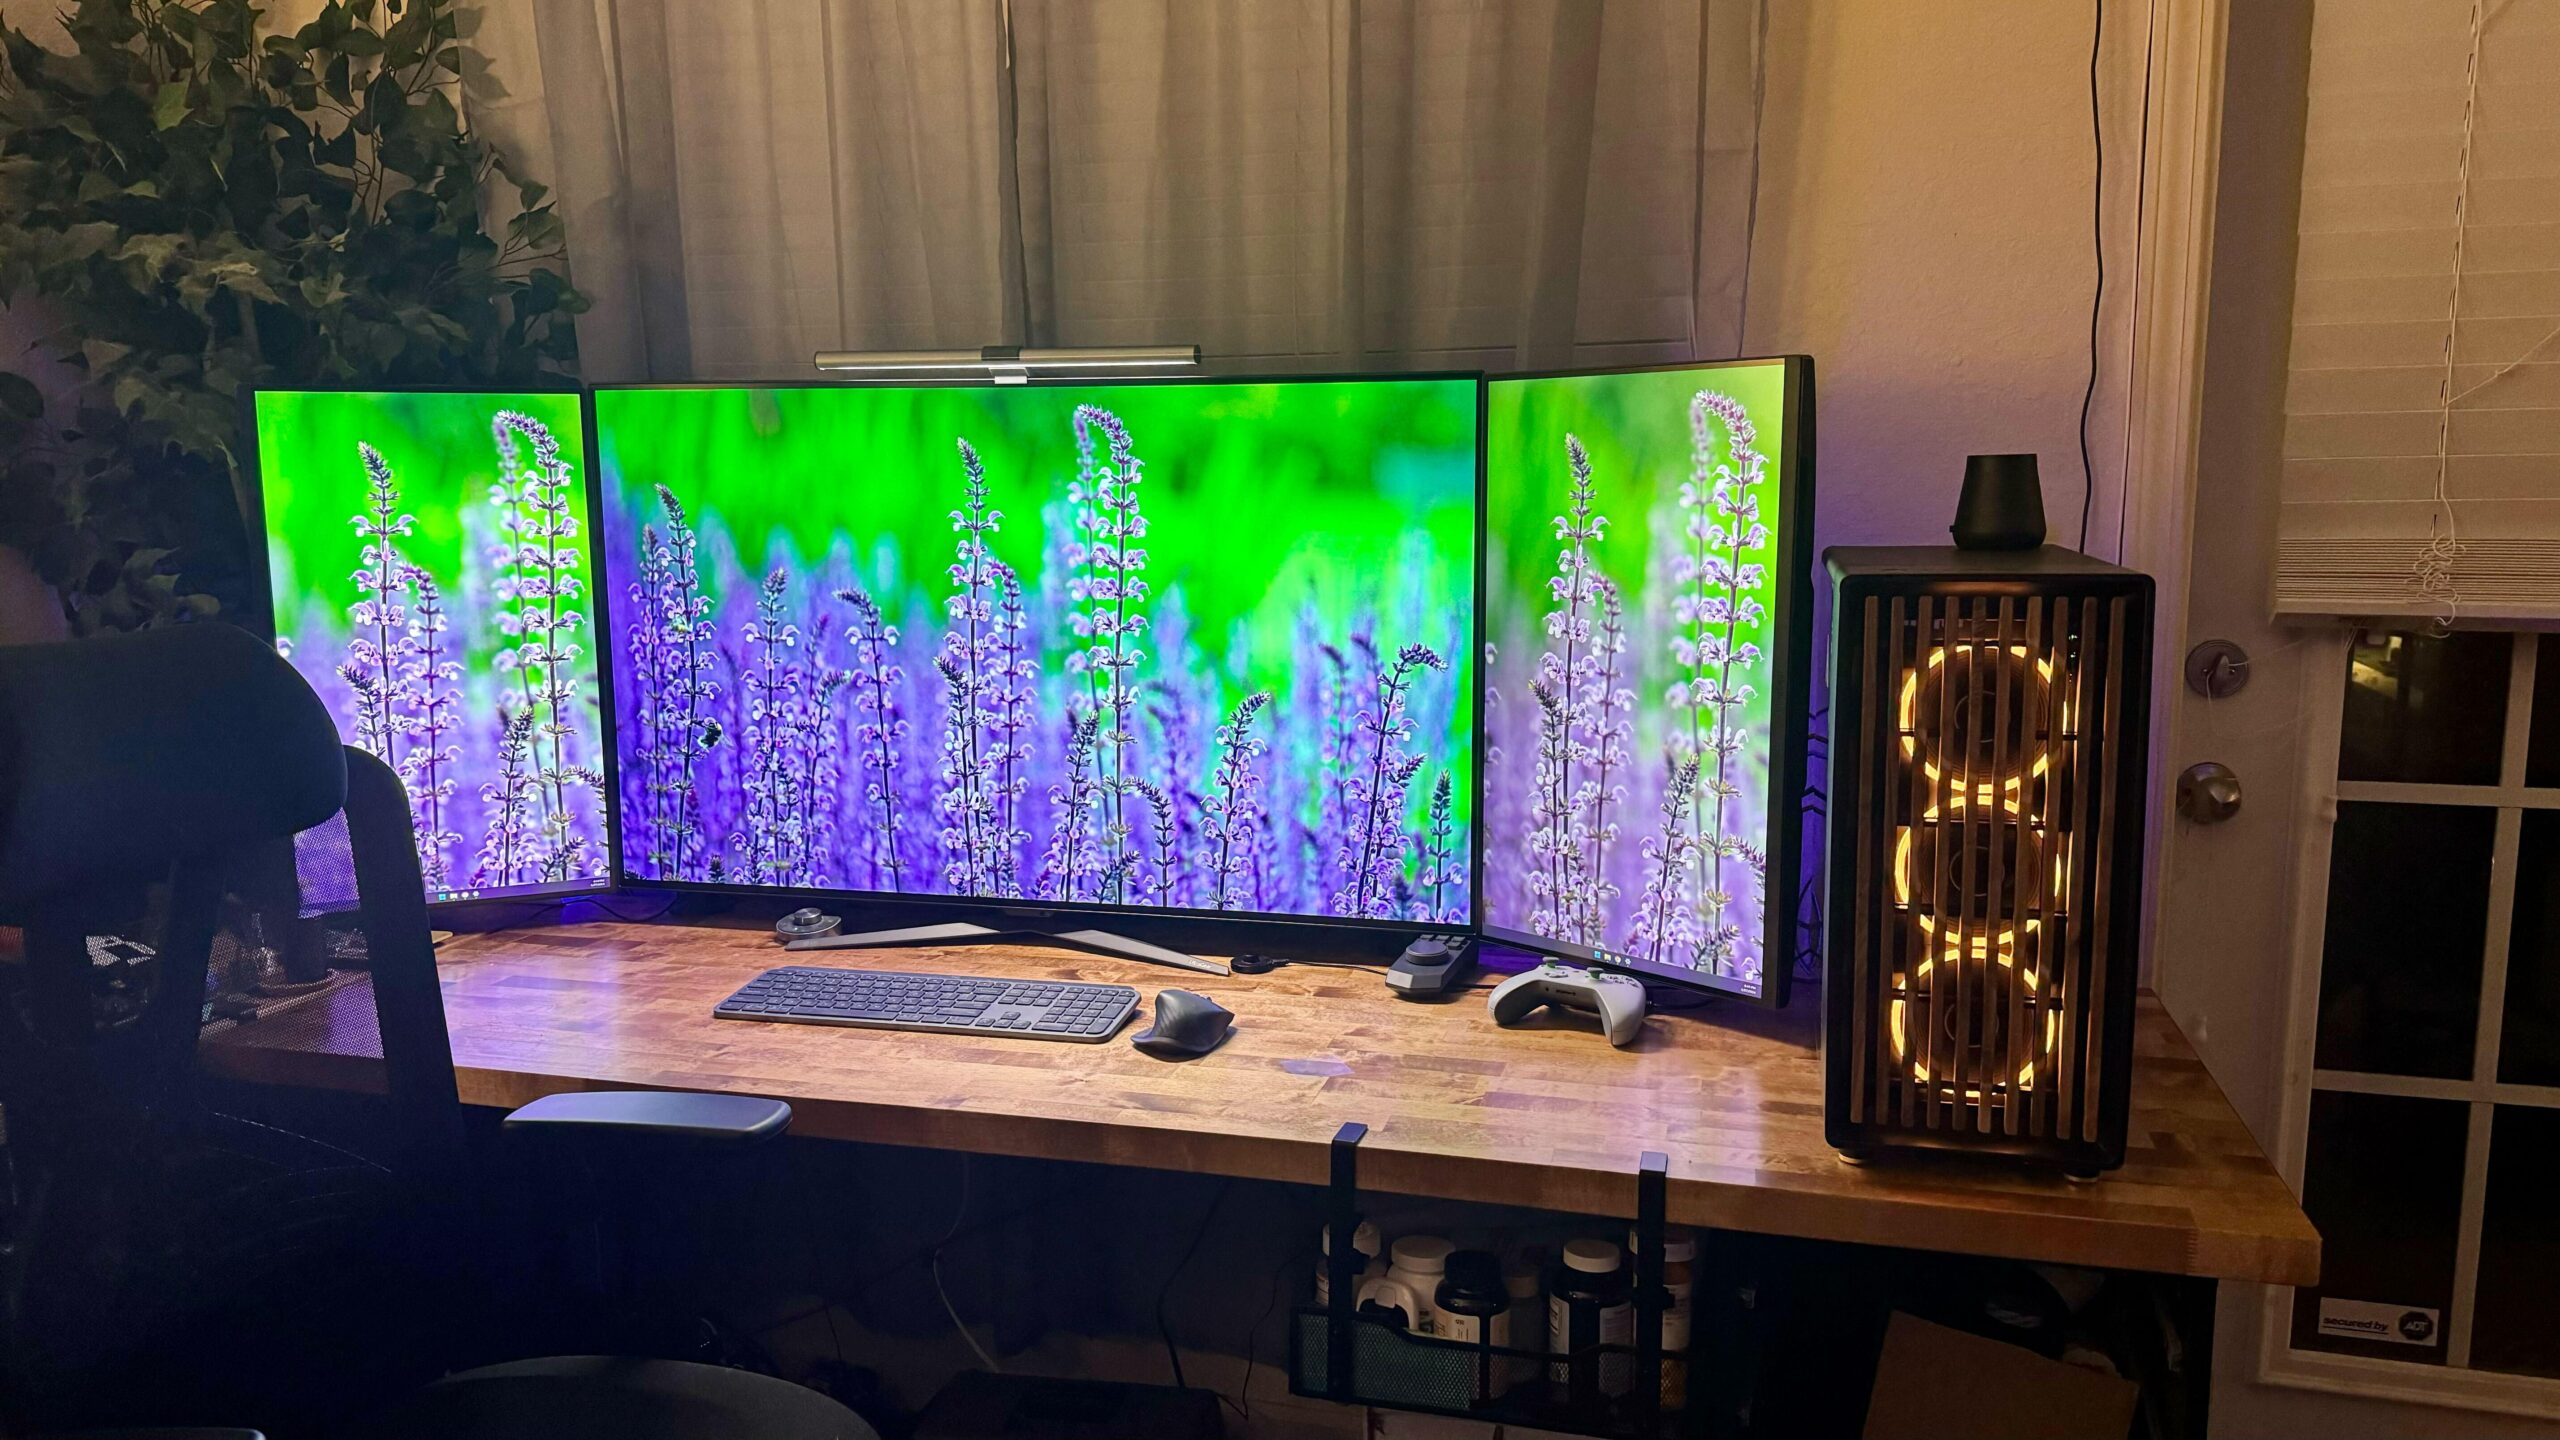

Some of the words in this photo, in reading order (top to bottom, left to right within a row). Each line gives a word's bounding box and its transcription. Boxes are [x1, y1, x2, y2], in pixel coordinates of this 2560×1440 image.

[2323, 1317, 2372, 1329] secured
[2375, 1321, 2389, 1332] by
[2403, 1320, 2430, 1332] ADT
